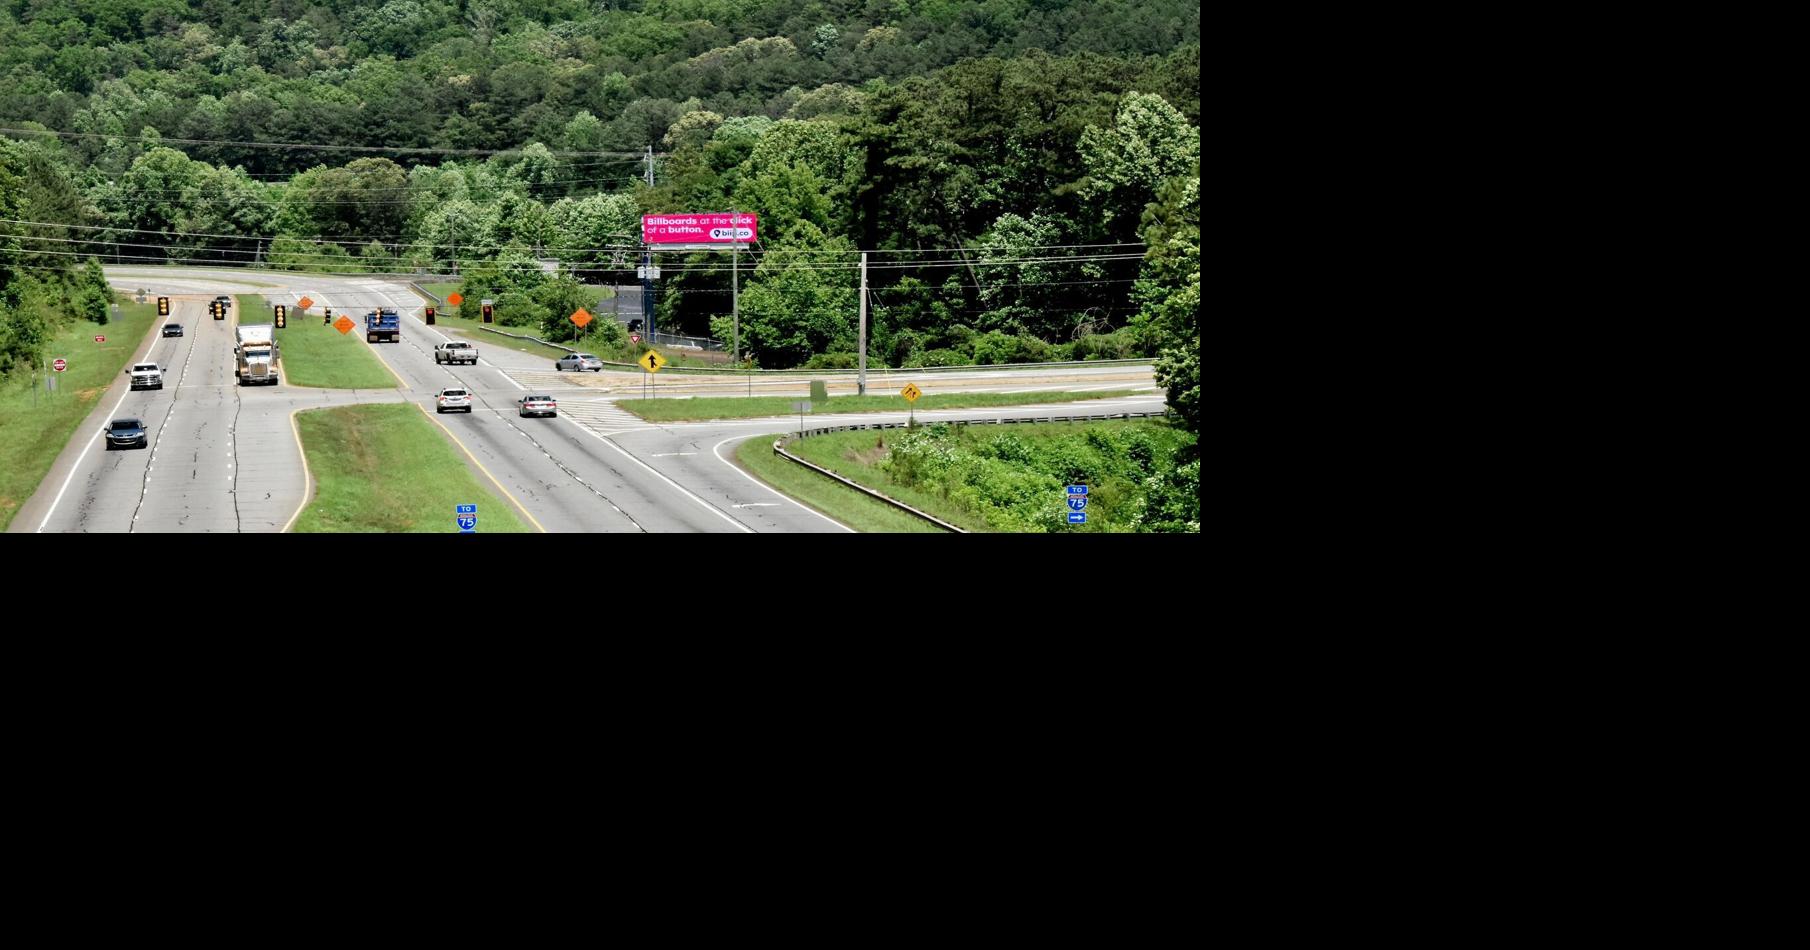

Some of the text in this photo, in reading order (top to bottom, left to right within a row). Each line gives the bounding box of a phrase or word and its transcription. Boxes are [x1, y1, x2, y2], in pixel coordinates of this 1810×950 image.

[647, 216, 752, 225] Billboards at the click
[647, 226, 656, 234] of
[1070, 498, 1085, 508] 75
[460, 518, 474, 527] 75
